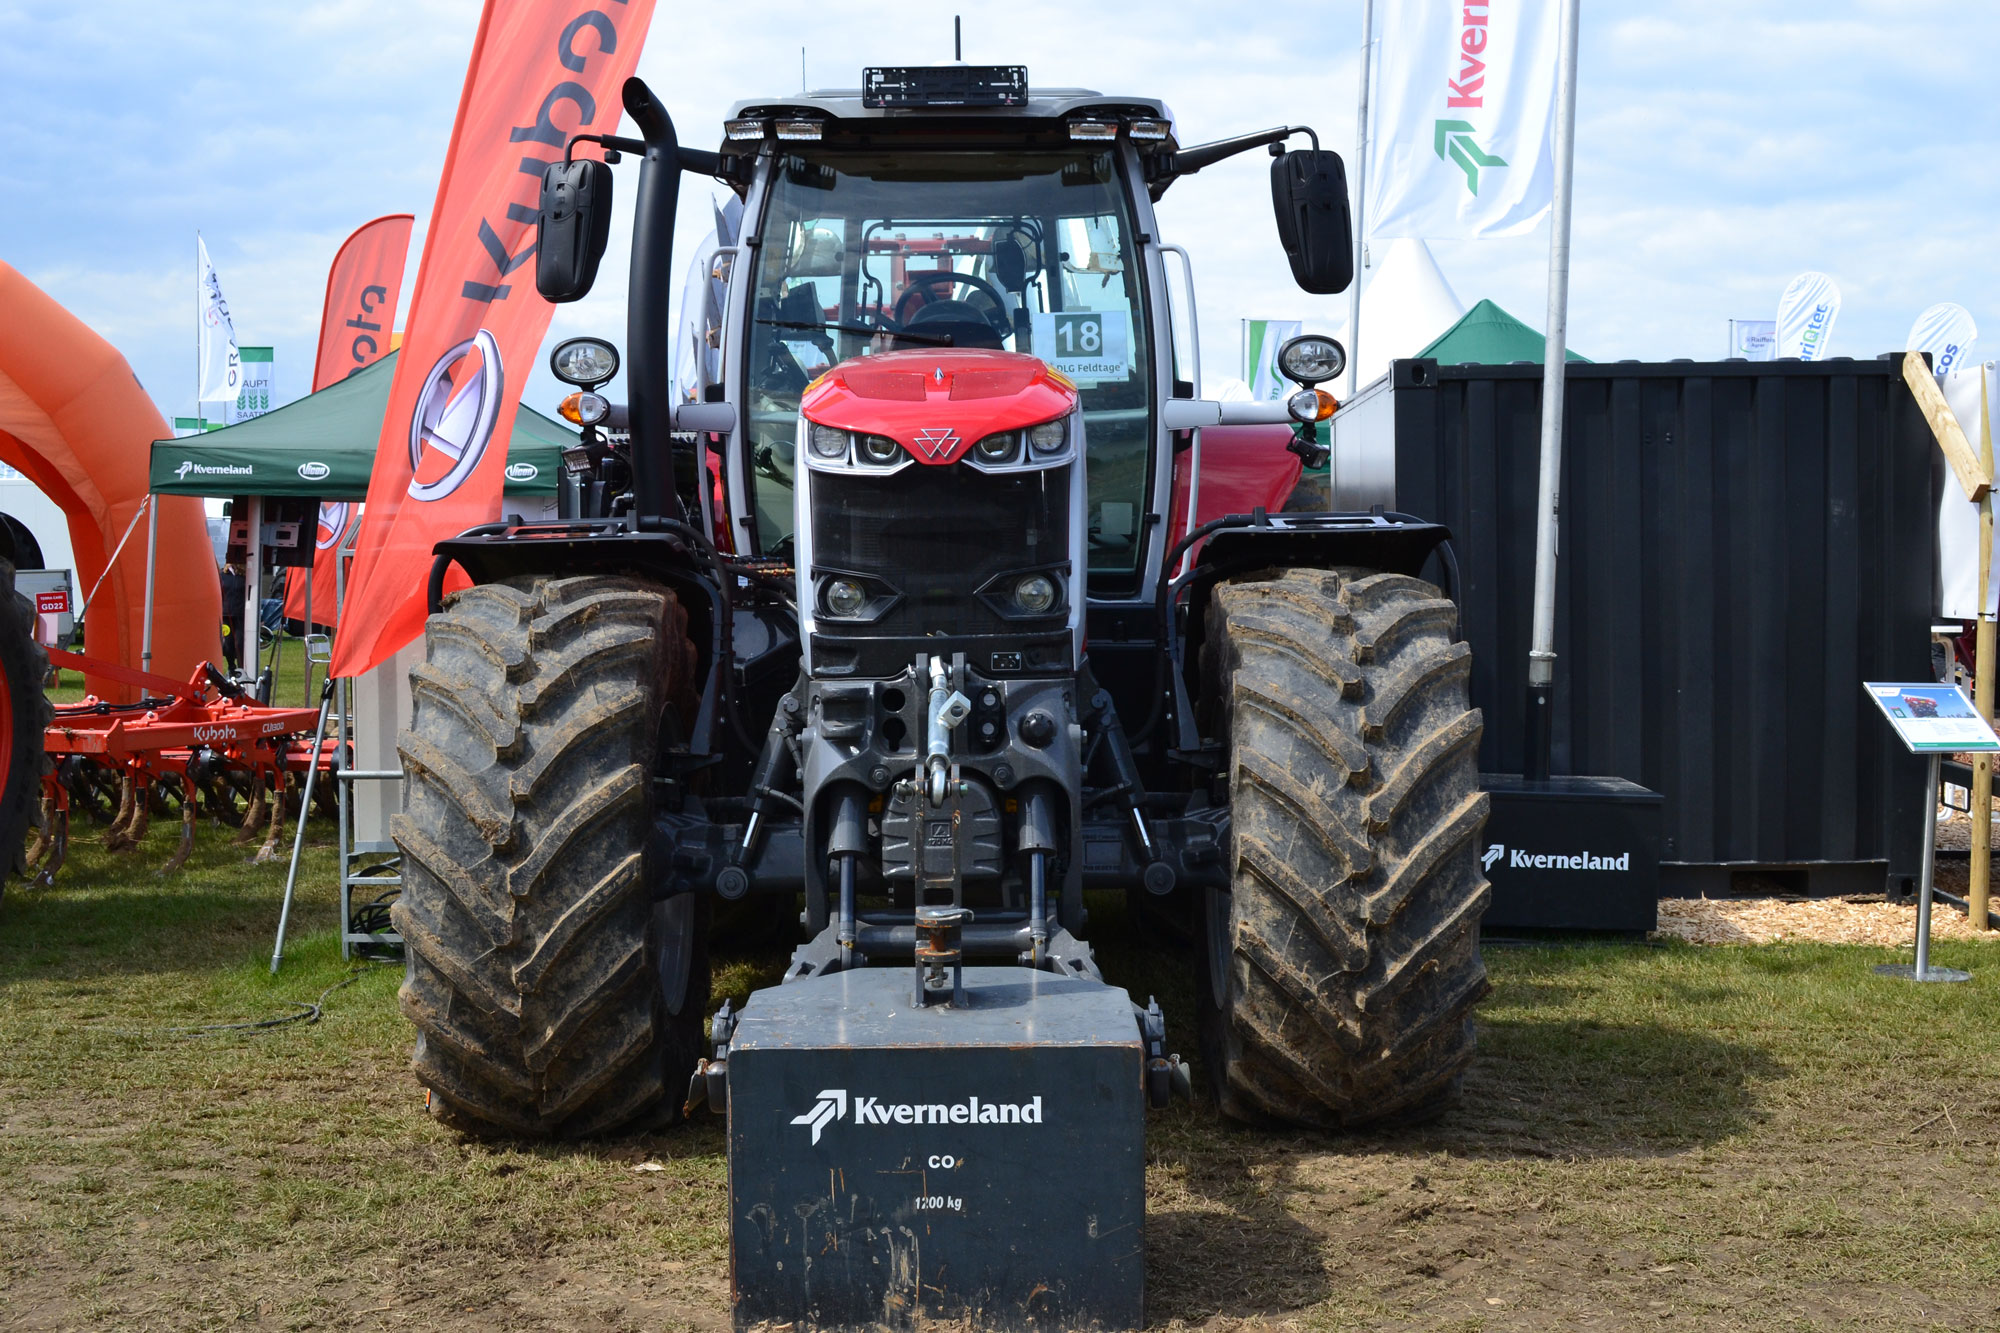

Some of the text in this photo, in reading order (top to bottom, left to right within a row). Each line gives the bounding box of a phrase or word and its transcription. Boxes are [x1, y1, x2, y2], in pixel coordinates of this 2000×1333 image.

[1058, 320, 1101, 353] 18
[1799, 303, 1829, 362] ariQtec
[1077, 361, 1121, 374] Feldtage
[241, 379, 269, 388] AUPT
[193, 463, 253, 476] Kverneland
[41, 602, 64, 611] GD22
[193, 724, 237, 742] Kubota
[1509, 848, 1630, 872] Kverneland
[854, 1095, 1043, 1125] Kverneland
[928, 1154, 955, 1169] CO
[915, 1195, 963, 1212] 1200 kg
